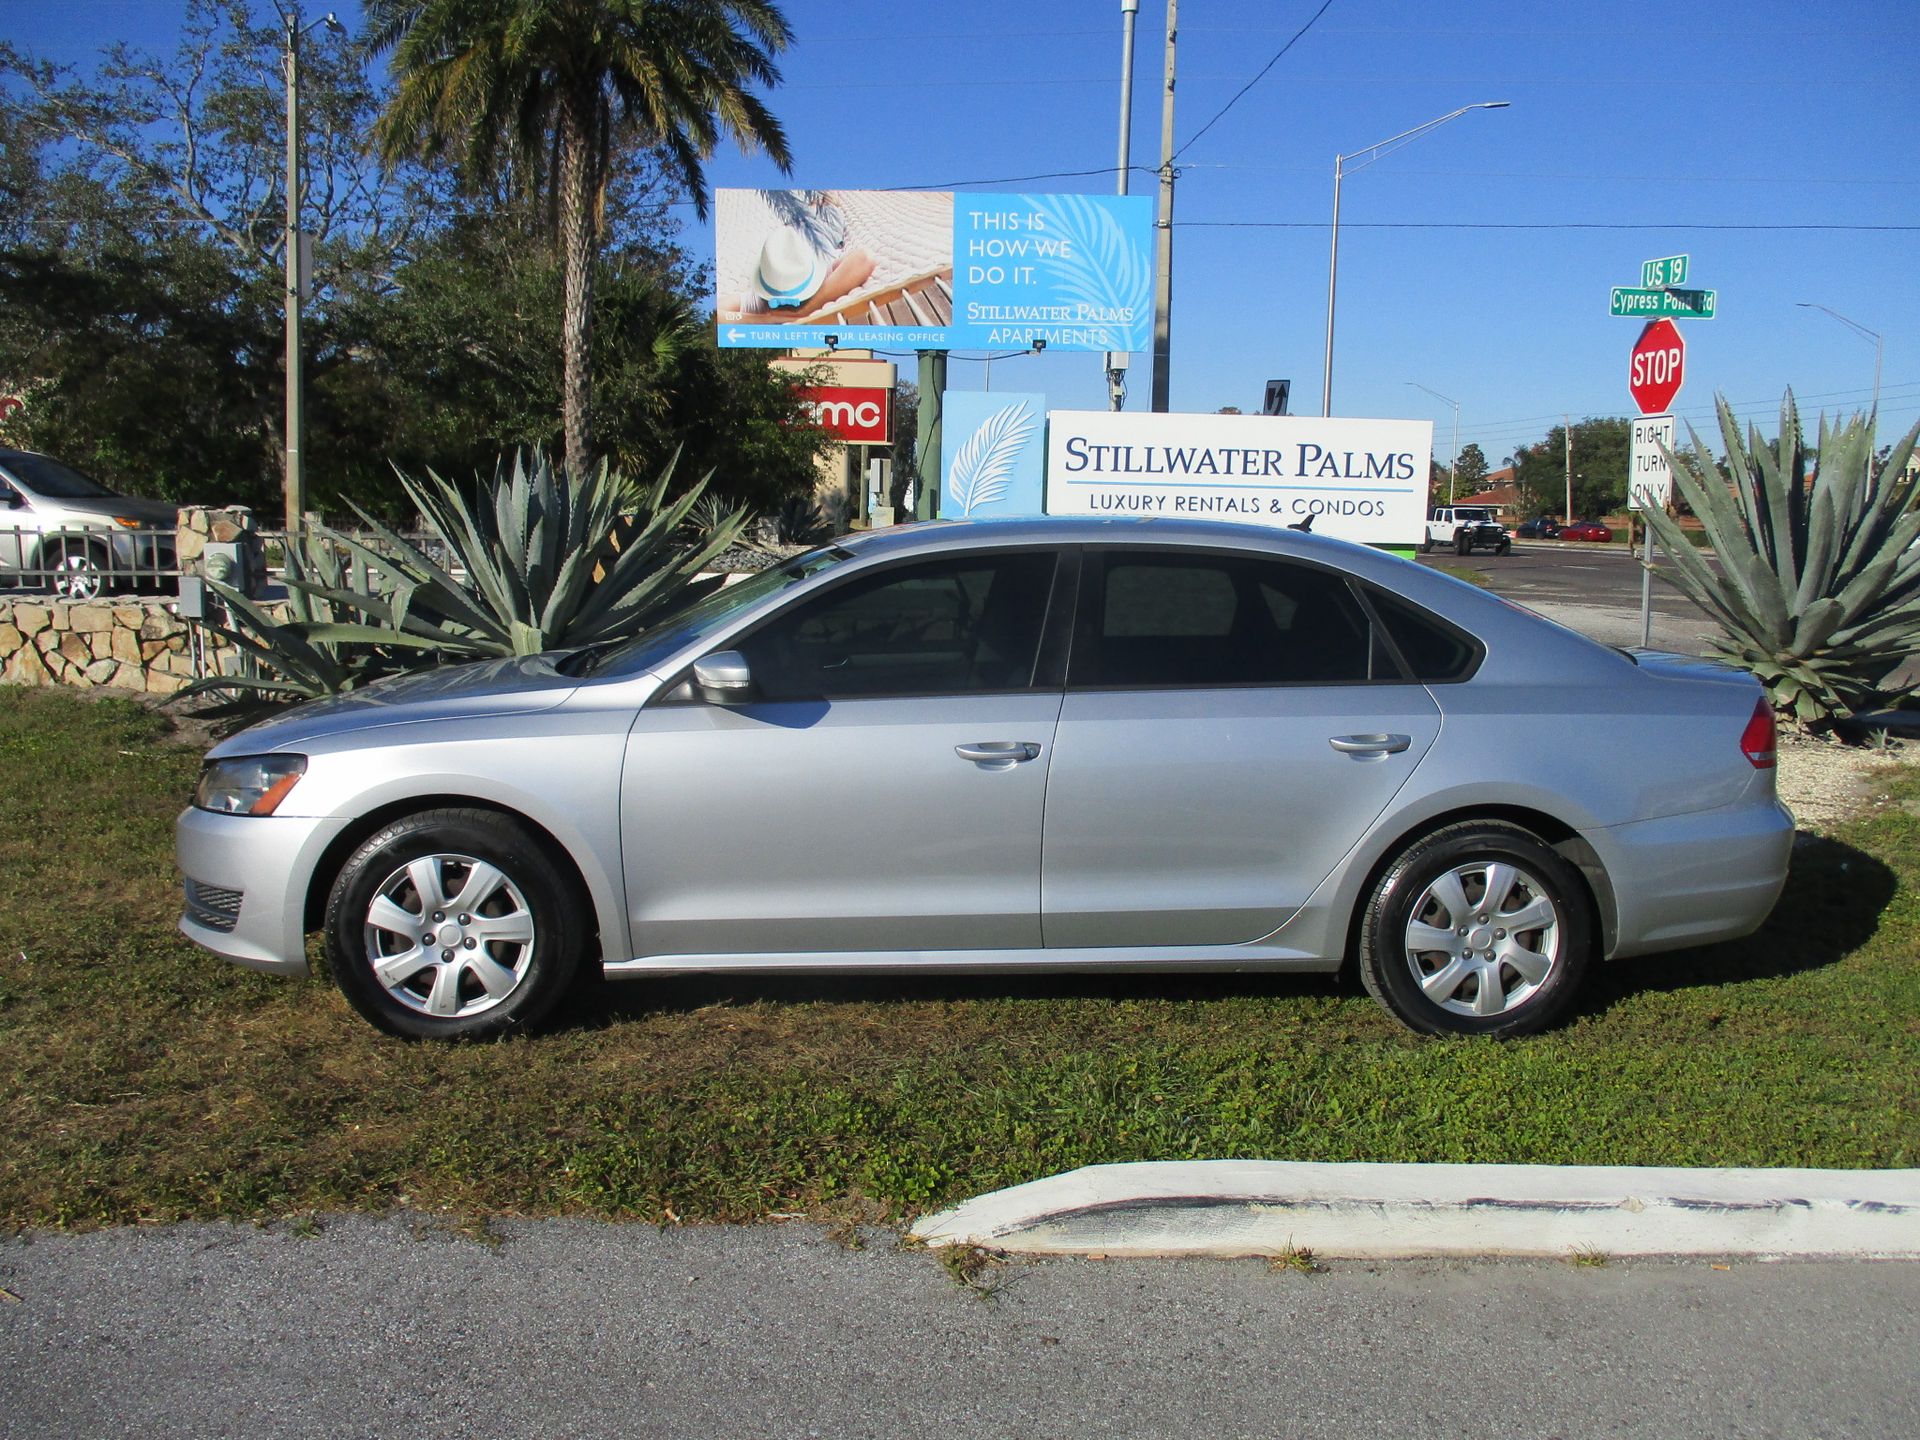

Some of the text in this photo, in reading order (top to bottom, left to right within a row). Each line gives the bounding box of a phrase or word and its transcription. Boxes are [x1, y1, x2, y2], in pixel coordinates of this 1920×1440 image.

[968, 211, 1046, 231] THIS IS
[969, 239, 1072, 259] HOW WE
[968, 266, 1037, 285] DO IT.
[1646, 257, 1683, 287] US 19
[967, 301, 1134, 322] STILLWATER PALMS
[1612, 289, 1659, 314] Cypress
[1663, 291, 1693, 311] Pond
[750, 330, 781, 341] TURN
[784, 331, 809, 341] LEFT
[812, 331, 826, 341] TO
[858, 332, 904, 342] LEASING
[907, 332, 945, 343] OFFICE
[987, 327, 1108, 345] APARTMENTS
[1633, 347, 1681, 387] STOP
[1635, 425, 1670, 445] RIGHT
[1065, 437, 1415, 480] STILLWATER PALMS
[1636, 455, 1667, 473] TURN
[1090, 493, 1385, 517] LUXURY RENTALS & CONDOS
